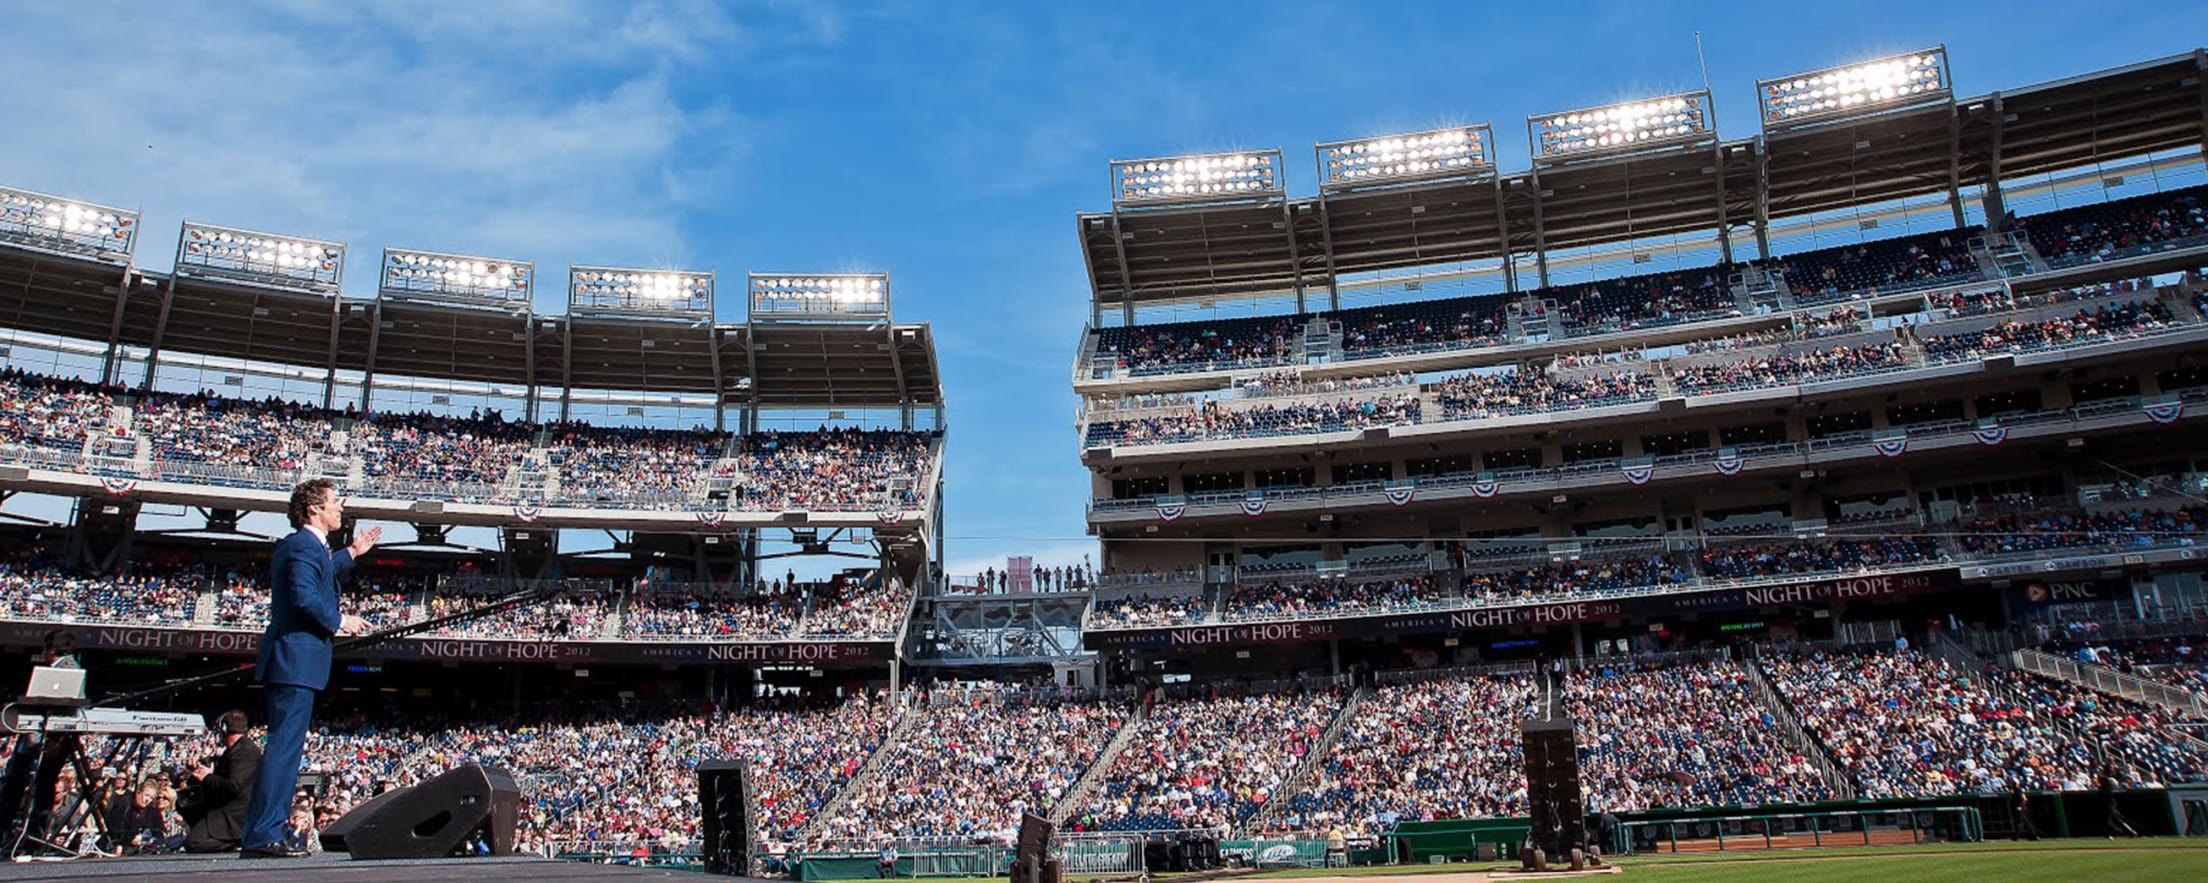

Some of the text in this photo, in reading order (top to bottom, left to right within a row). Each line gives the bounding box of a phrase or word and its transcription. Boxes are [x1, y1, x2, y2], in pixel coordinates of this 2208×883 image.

[1988, 564, 2032, 574] CARTER
[2056, 558, 2106, 569] DAWSON
[1746, 584, 1815, 605] NIGHT
[1836, 576, 1894, 598] HOPE
[1901, 577, 1929, 588] 2012
[2049, 581, 2096, 599] PNC
[1450, 608, 1516, 628] NIGHT
[1535, 603, 1588, 622] HOPE
[1594, 604, 1620, 615] 2012
[98, 629, 178, 648] NIGHT
[199, 632, 257, 651] HOPE
[1171, 627, 1234, 645] NIGHT
[1252, 623, 1301, 641] HOPE
[1308, 625, 1333, 634] 2012
[421, 641, 489, 657] NIGHT
[507, 643, 558, 659] HOPE
[565, 647, 591, 656] 2012
[707, 644, 771, 660] NIGHT
[788, 645, 837, 659] HOPE
[844, 647, 869, 655] 2012
